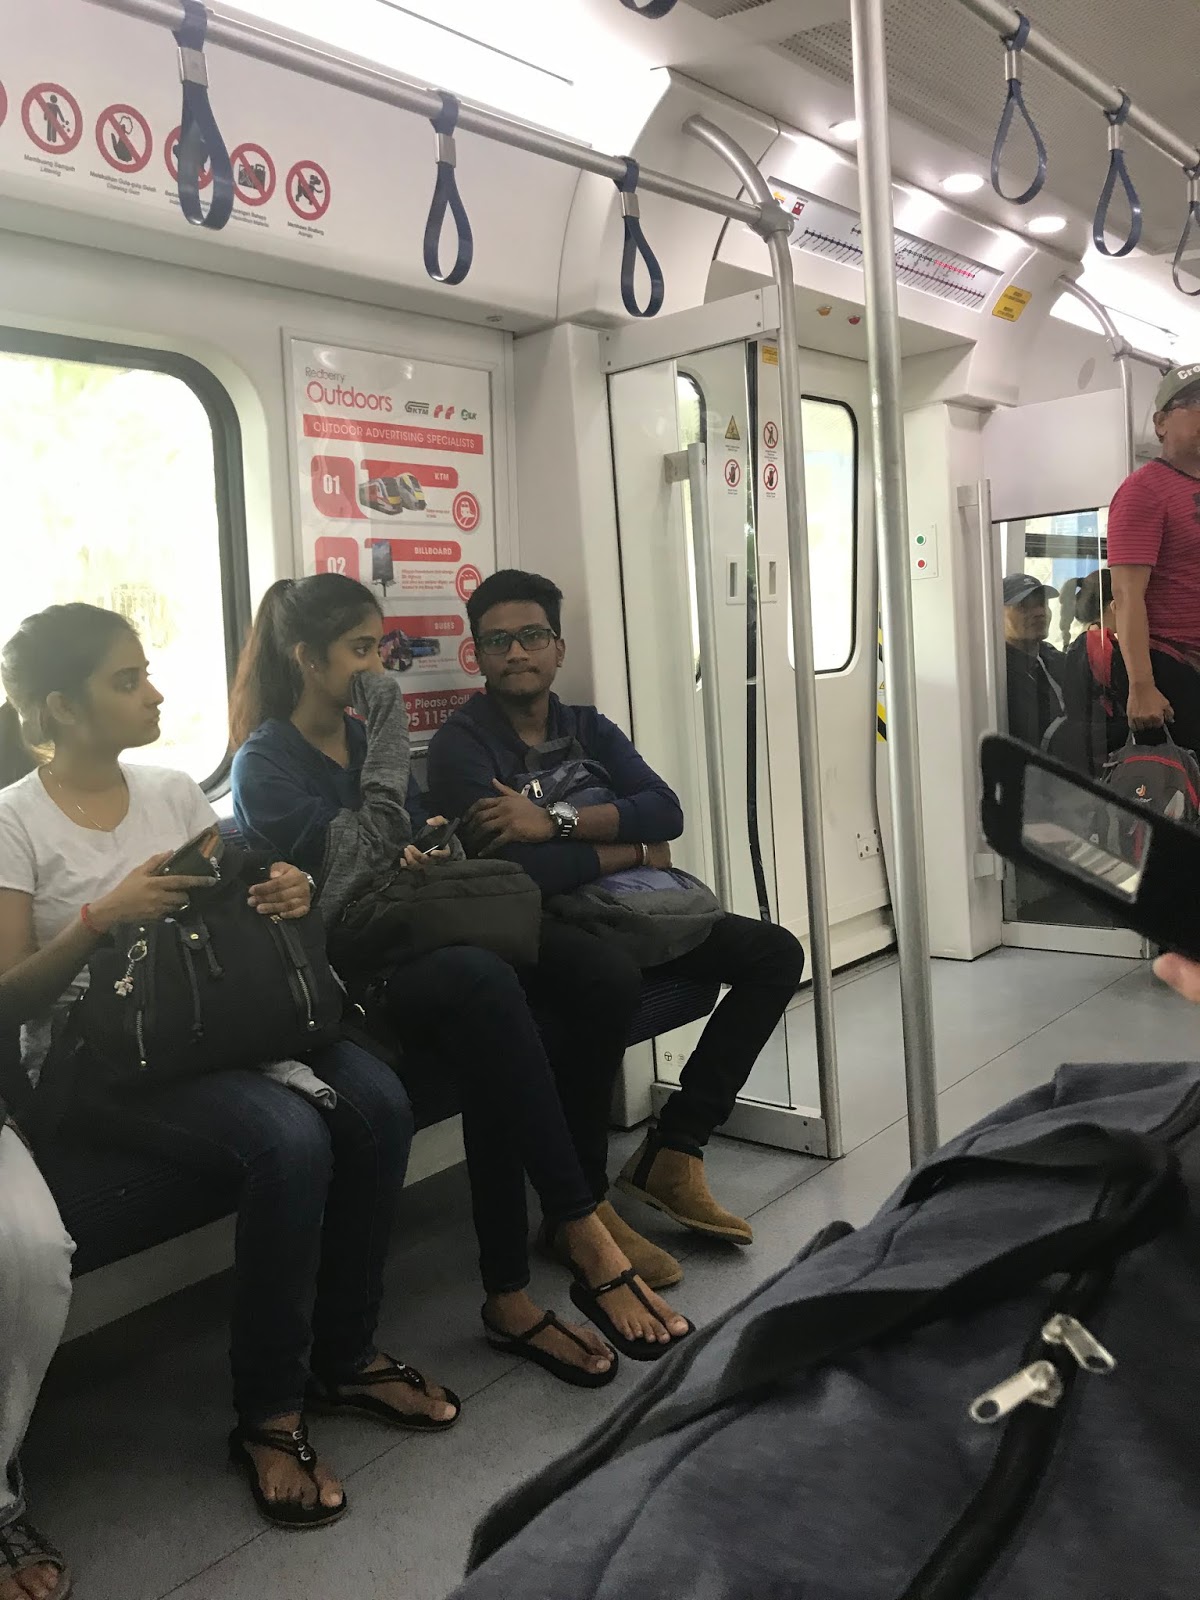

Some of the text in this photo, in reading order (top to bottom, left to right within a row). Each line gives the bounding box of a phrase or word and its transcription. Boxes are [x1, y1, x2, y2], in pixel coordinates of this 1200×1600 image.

[305, 366, 345, 383] Redberry
[306, 380, 393, 412] Outdoors
[313, 421, 475, 449] OUTDOOR ADVERTISING SPECIALISTS
[323, 474, 340, 495] 01
[434, 472, 450, 481] KTM
[414, 546, 452, 556] BILLBOARD
[327, 556, 346, 574] 02
[434, 621, 455, 630] BUSES
[415, 697, 448, 709] Please
[450, 694, 470, 705] Call
